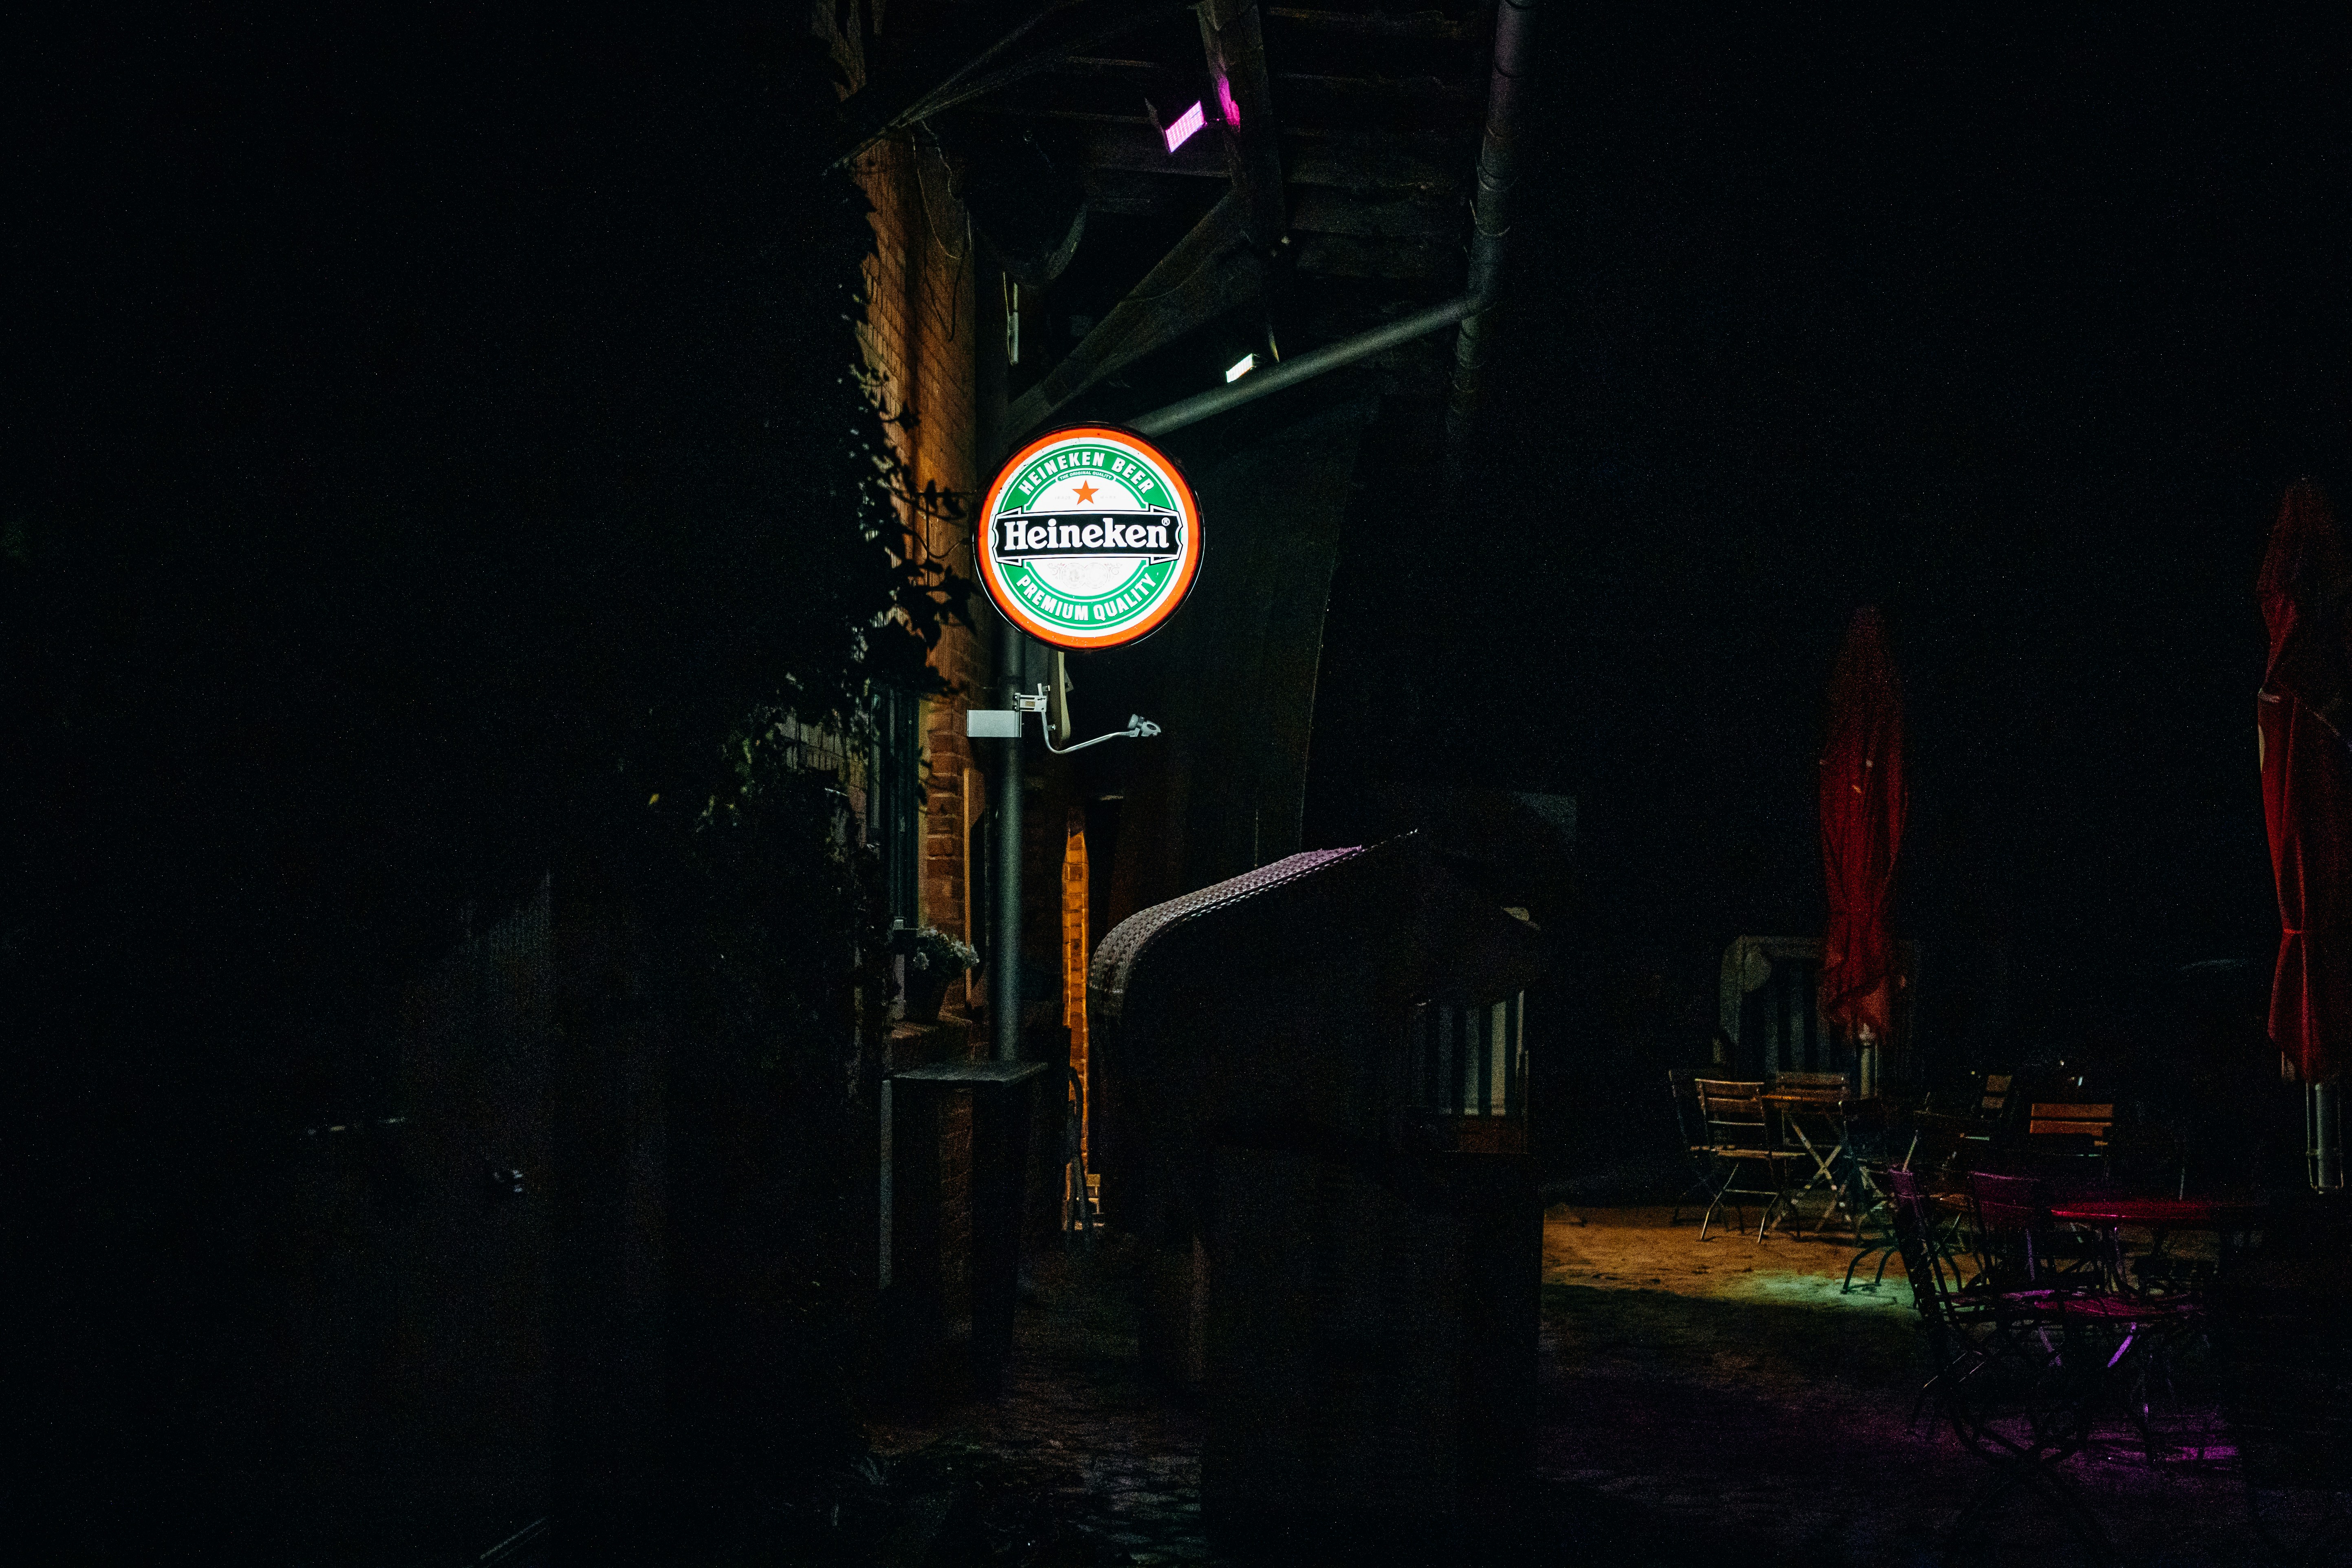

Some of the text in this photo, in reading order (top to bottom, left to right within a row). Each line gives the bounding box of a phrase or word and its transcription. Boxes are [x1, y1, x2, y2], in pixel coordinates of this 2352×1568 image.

[1018, 451, 1155, 496] HEINEKEN BEER
[1092, 471, 1112, 479] QUALITY
[1016, 574, 1088, 621] PREMIUM
[1093, 573, 1157, 621] QUALITY
